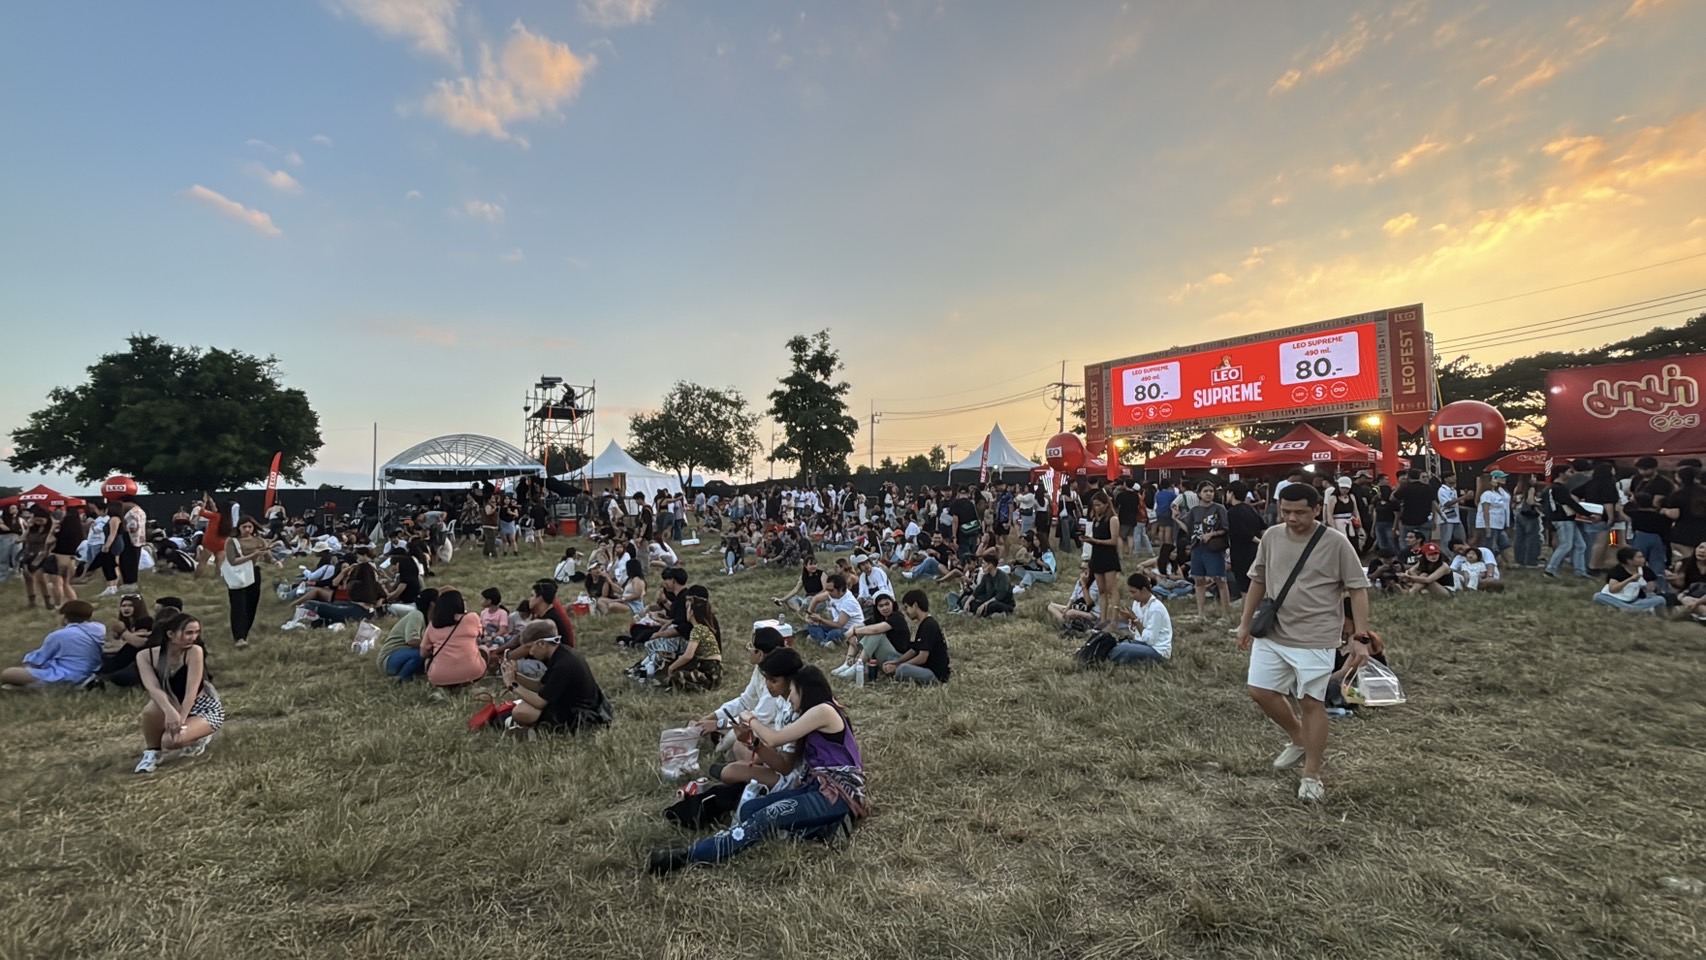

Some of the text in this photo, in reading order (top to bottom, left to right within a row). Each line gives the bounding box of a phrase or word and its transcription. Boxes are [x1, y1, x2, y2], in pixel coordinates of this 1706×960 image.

[1292, 336, 1343, 349] LEO SUPREME
[1143, 365, 1169, 374] SUPREME
[1295, 357, 1343, 380] 80.-
[1400, 329, 1416, 395] LEOFEST
[1213, 368, 1240, 382] LEO
[1134, 382, 1169, 402] 80.-
[1193, 381, 1263, 409] SUPREME
[1090, 381, 1099, 429] LEOFEST
[1442, 426, 1479, 438] LEO
[1274, 442, 1305, 450] LEO
